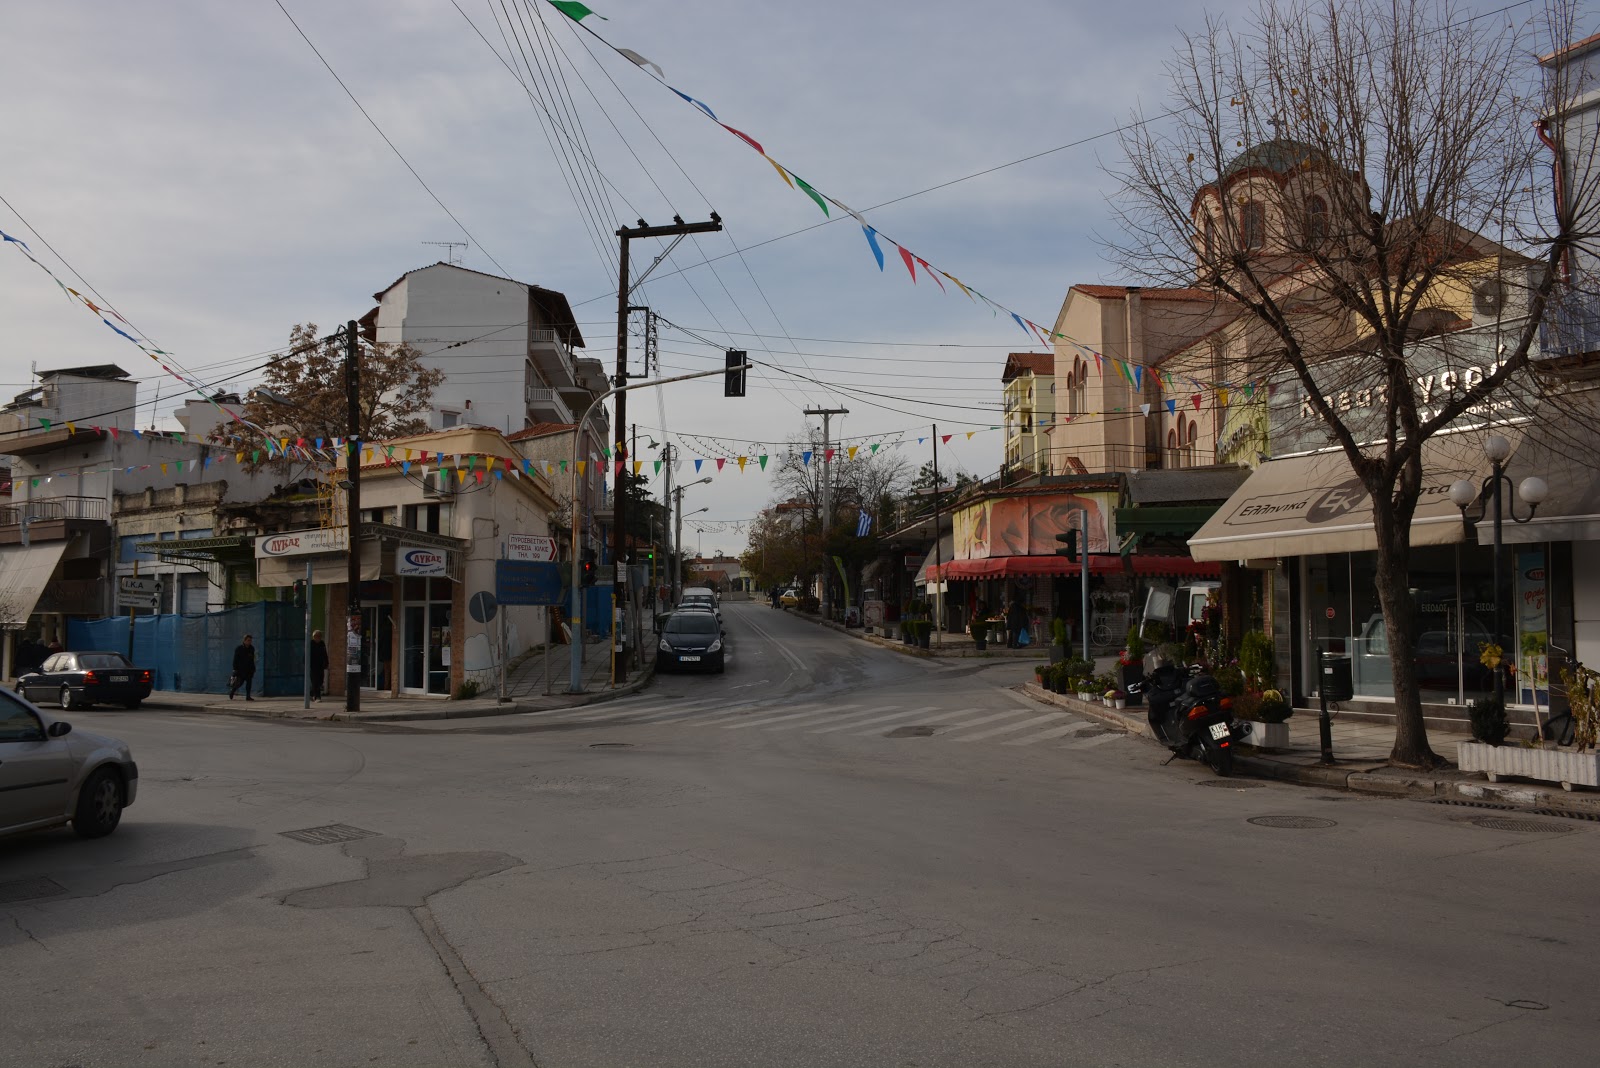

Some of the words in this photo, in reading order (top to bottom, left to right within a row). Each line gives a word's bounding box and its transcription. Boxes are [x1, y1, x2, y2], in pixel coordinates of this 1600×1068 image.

[271, 538, 300, 552] ΛΥΚΑΣ
[414, 555, 442, 564] ΛΥΚΑΣ
[1421, 603, 1448, 613] ΕΙΣΟΔΟΣ
[1475, 602, 1496, 612] ΕΙΣΟΔ
